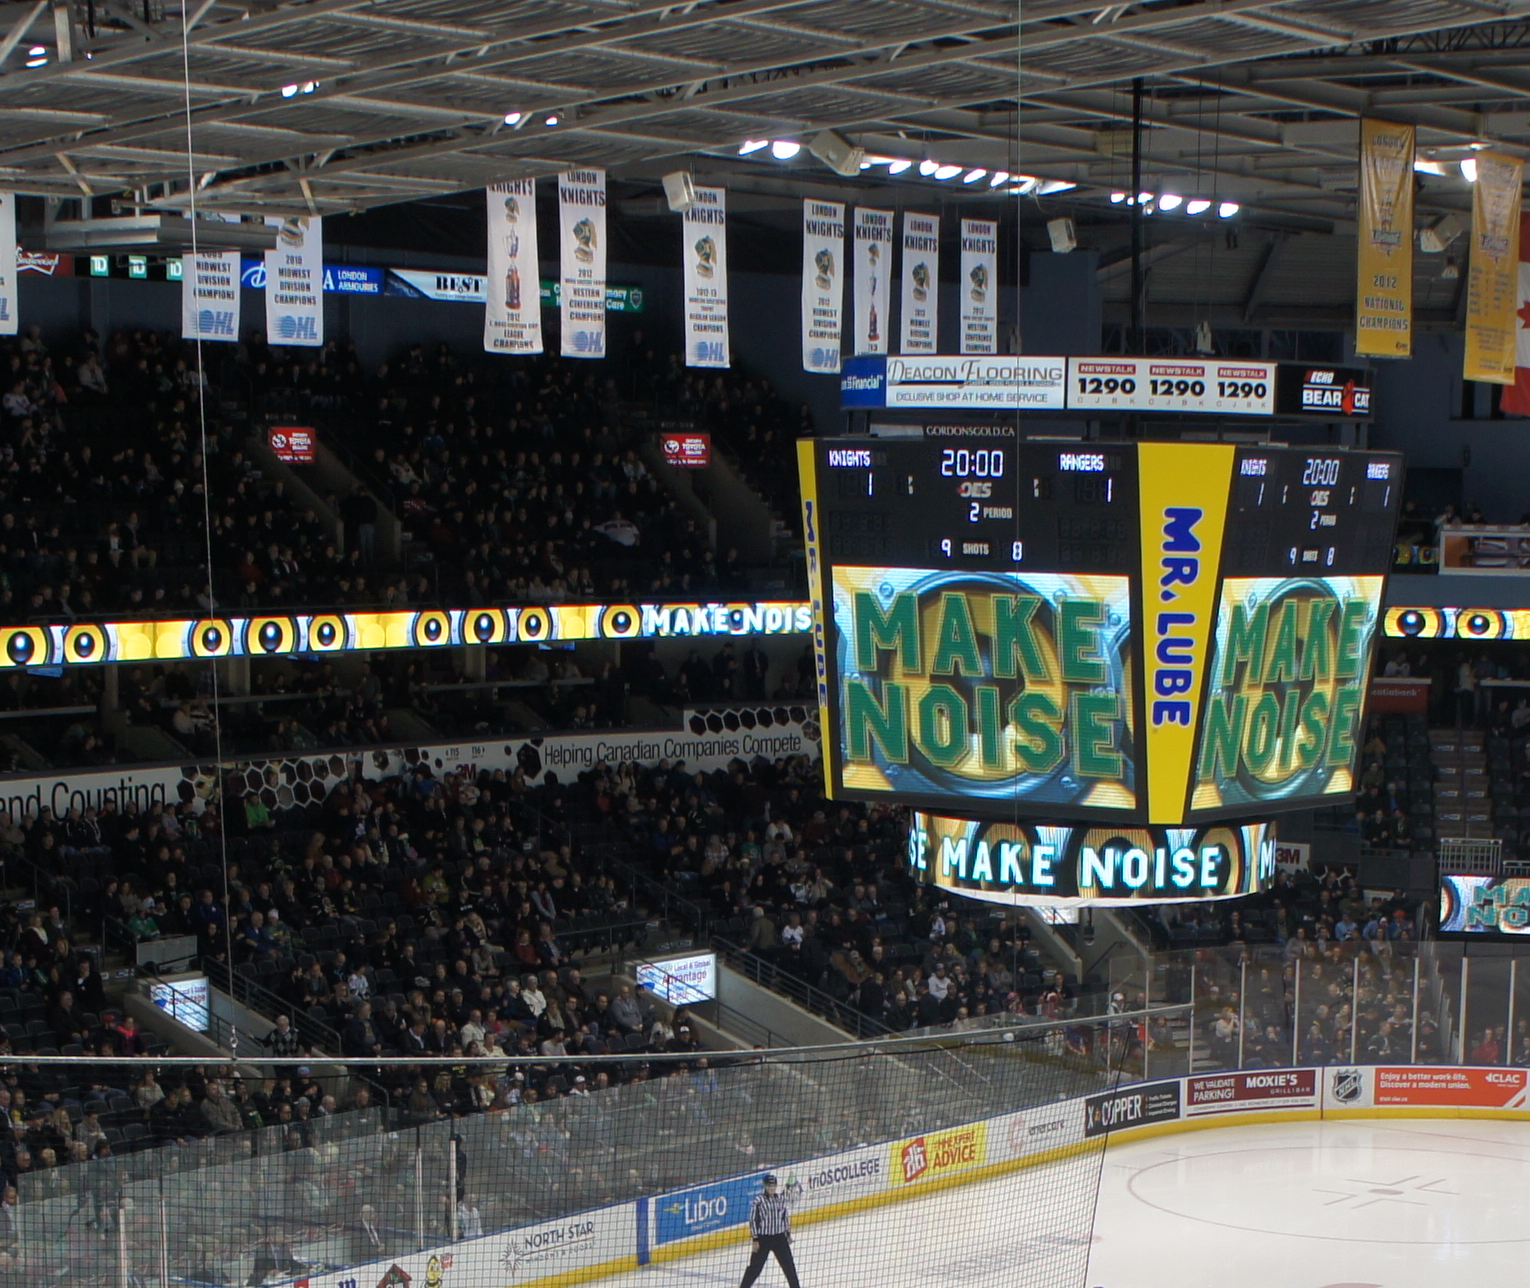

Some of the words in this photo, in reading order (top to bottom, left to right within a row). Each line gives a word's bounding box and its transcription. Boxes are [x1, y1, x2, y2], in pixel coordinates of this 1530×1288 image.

[93, 257, 107, 273] TD
[133, 259, 147, 274] TD
[1373, 275, 1397, 289] 2012
[1364, 296, 1405, 312] NATIONAL
[1360, 315, 1409, 331] CHAMPIONS
[888, 359, 957, 386] DEACON
[958, 360, 1063, 389] FLOORING
[1080, 364, 1135, 374] NEWSTALK
[1151, 366, 1203, 376] NEWSTALK
[1220, 369, 1267, 378] NEWSTALK
[1310, 371, 1335, 384] ECHO
[1078, 377, 1137, 395] 1290
[1150, 379, 1206, 397] 1290
[1218, 381, 1267, 398] 1290
[896, 392, 935, 403] EXCLUSIVE
[937, 392, 960, 403] SHOP
[961, 392, 974, 402] AT
[975, 392, 1005, 403] HOME
[1006, 393, 1048, 404] SERVICE
[1303, 390, 1342, 406] BEAR
[926, 425, 1015, 437] GORDONSGOLD.CA
[941, 449, 1004, 477] 20:00
[1059, 454, 1105, 471] RANGERS
[1303, 458, 1341, 486] 20:00
[969, 502, 980, 522] 2
[983, 507, 1013, 519] PERIOD
[941, 538, 952, 558] 9
[962, 543, 989, 555] SHOTS
[1012, 541, 1023, 561] 8
[744, 606, 812, 633] NOIS
[851, 588, 1109, 686] MAKE
[1223, 597, 1370, 689] MAKE
[1150, 611, 1196, 729] LUBE
[842, 680, 1124, 779] NOISE
[1198, 688, 1361, 779] NOISE
[544, 743, 592, 767] Helping
[597, 739, 661, 763] Canadian
[664, 736, 740, 762] Companies
[743, 733, 802, 756] Compete
[51, 778, 167, 822] Counting
[941, 834, 1056, 887] MAKE
[1080, 845, 1220, 891] NOISE
[1275, 849, 1300, 865] 3M
[1246, 1074, 1298, 1089] MOXIE'S
[1380, 1072, 1400, 1081] Enjoy
[1408, 1072, 1431, 1081] better
[1380, 1081, 1410, 1089] Discover
[1418, 1081, 1446, 1089] modern
[1492, 1073, 1521, 1084] CLAC
[1194, 1088, 1235, 1103] PARKING!
[1102, 1094, 1143, 1127] COPPER
[933, 1139, 976, 1171] ADVICE
[684, 1194, 728, 1226] Libro
[525, 1228, 565, 1249] NORTH
[567, 1221, 595, 1240] STAR
